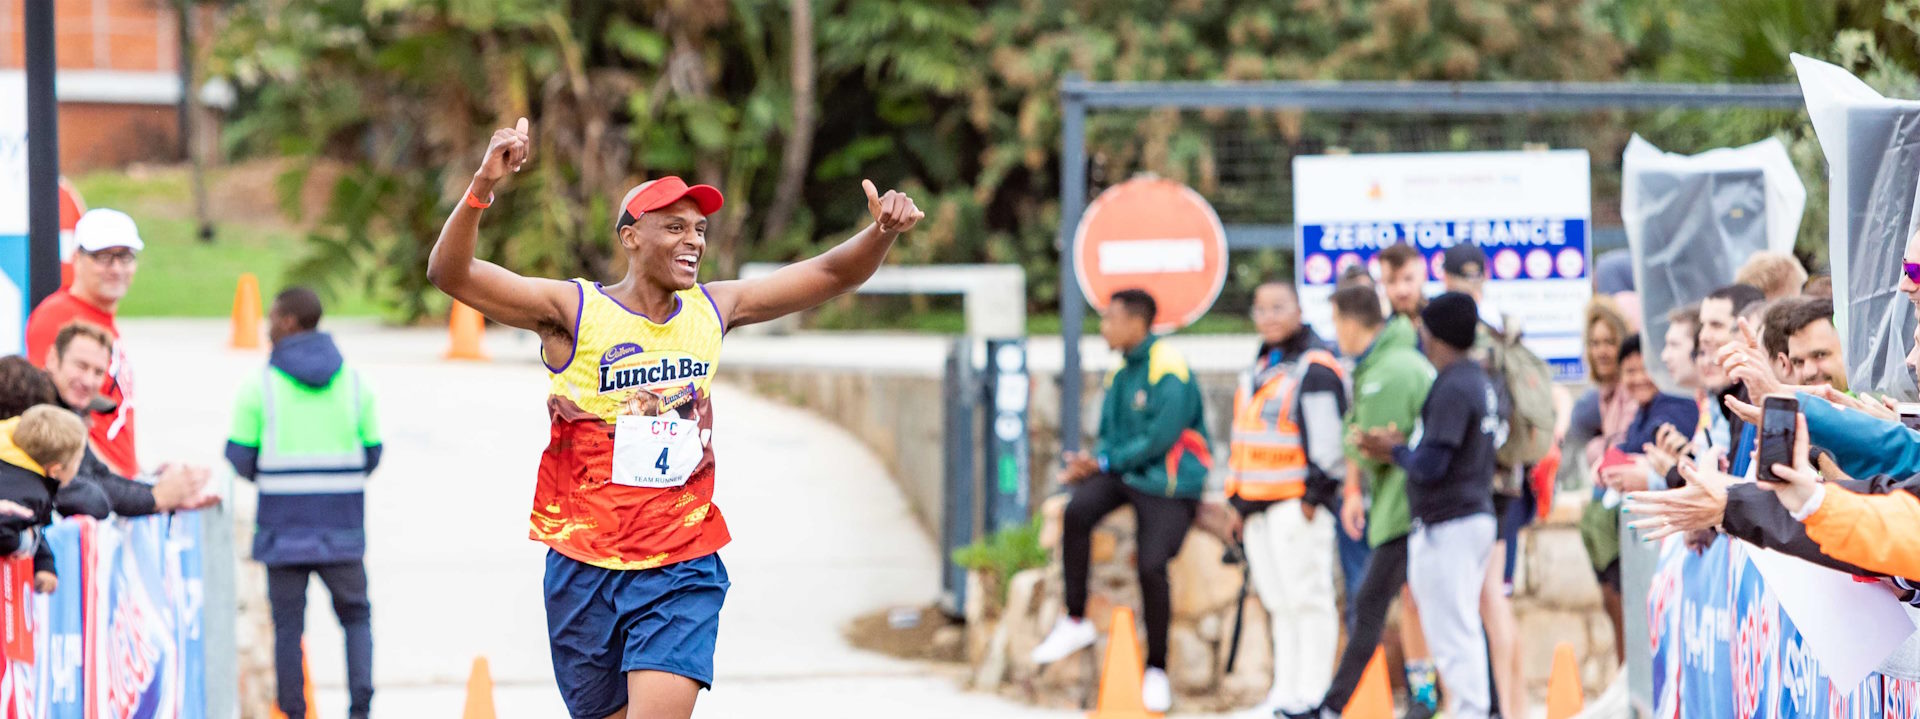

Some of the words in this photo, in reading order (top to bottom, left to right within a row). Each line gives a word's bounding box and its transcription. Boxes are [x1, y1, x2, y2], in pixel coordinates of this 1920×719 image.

[1320, 224, 1397, 250] ZERO
[1401, 220, 1566, 248] TOLERANCE
[605, 346, 635, 361] Cadbury
[600, 358, 676, 392] Lunch
[679, 358, 709, 378] Bar
[651, 420, 678, 436] CTC
[655, 447, 670, 475] 4
[634, 475, 654, 483] TEAM
[655, 475, 683, 484] RUNNER
